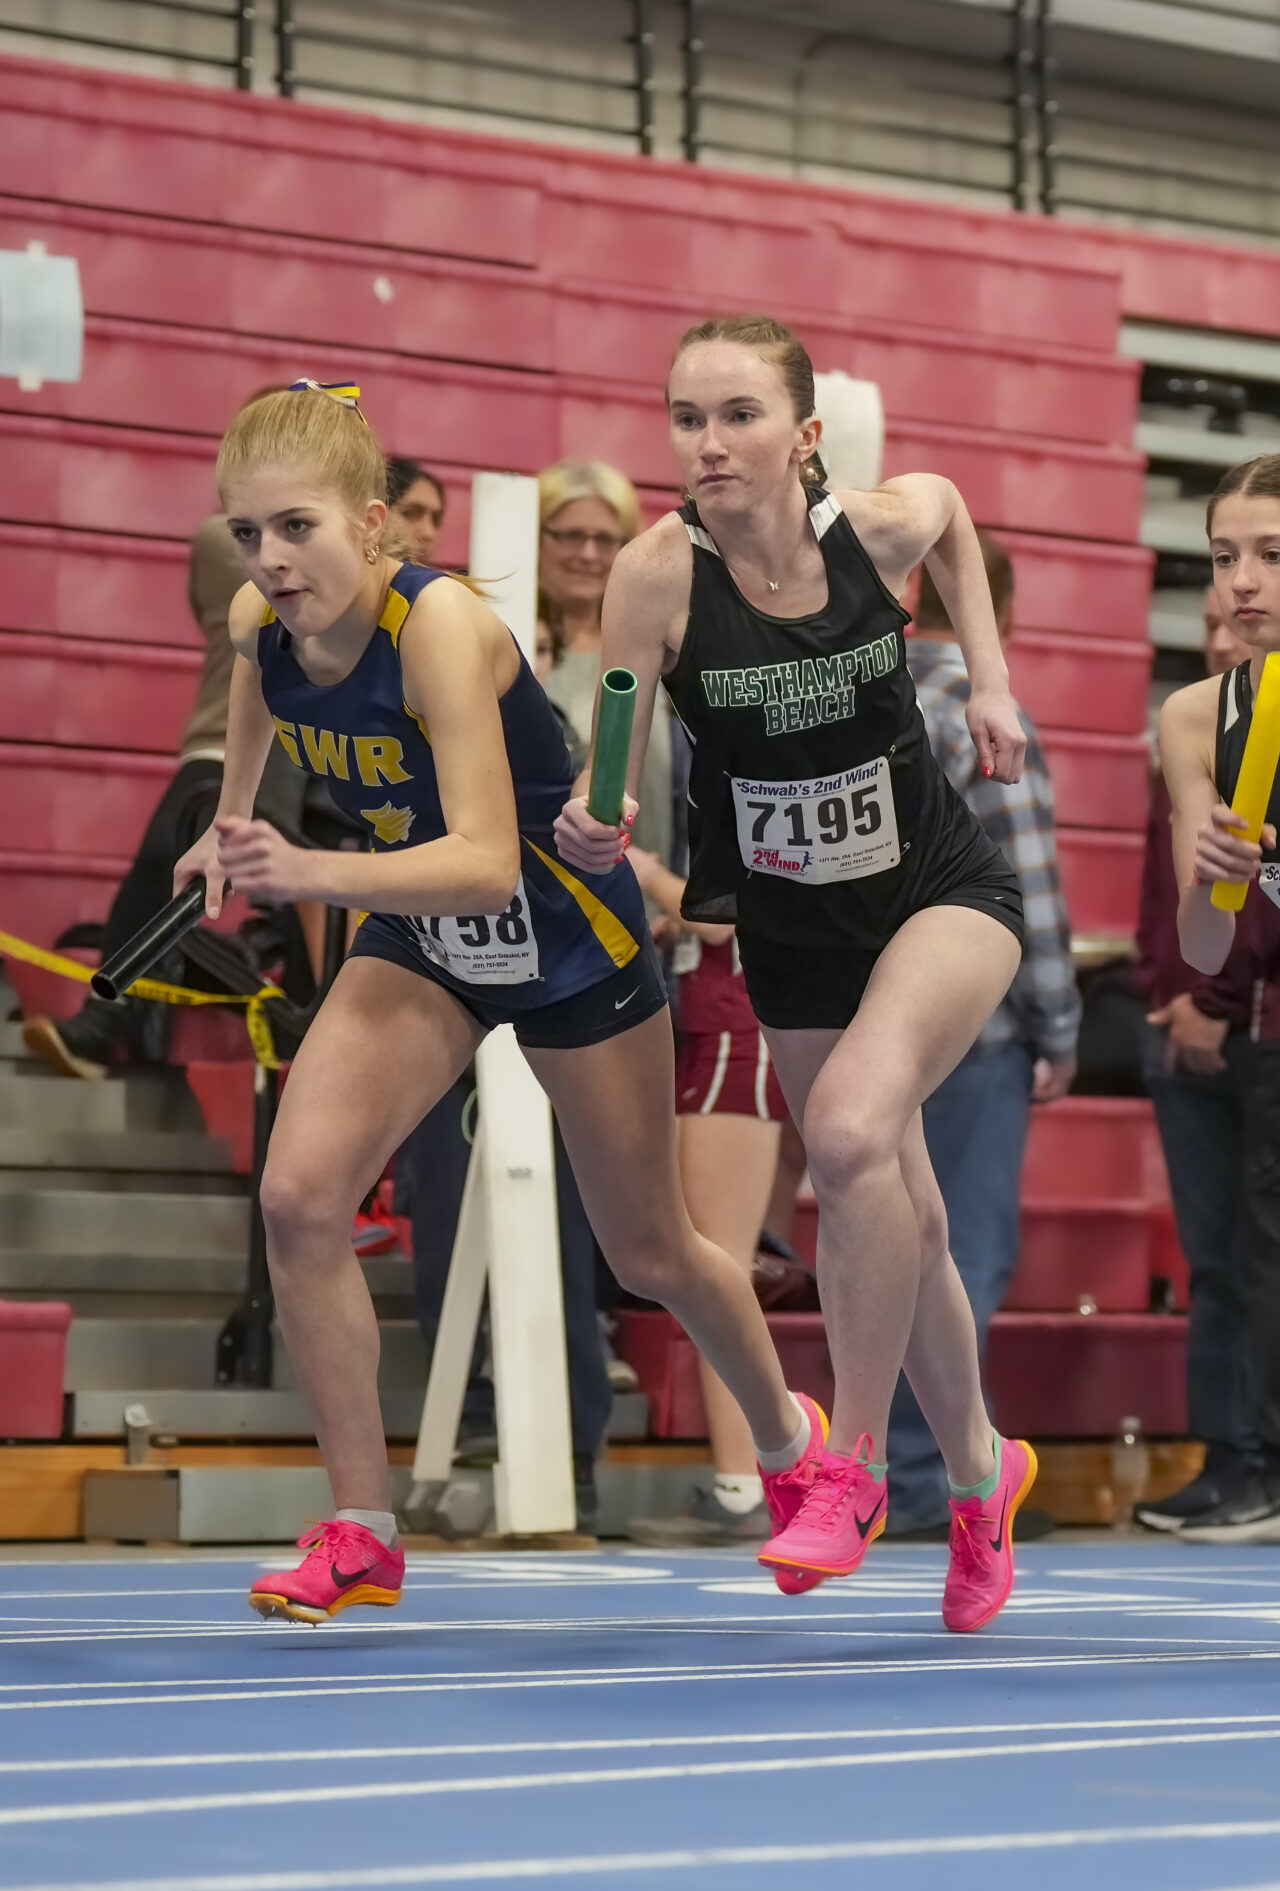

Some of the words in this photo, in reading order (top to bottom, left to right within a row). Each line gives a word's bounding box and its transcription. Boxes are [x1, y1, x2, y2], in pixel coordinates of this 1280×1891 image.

[701, 632, 898, 707] WESTHAMPTON
[764, 685, 856, 737] BEACH
[740, 781, 810, 797] Schwab's
[814, 777, 842, 794] 2nd
[846, 762, 879, 786] Wind
[746, 783, 882, 847] 7195
[752, 849, 779, 865] 2nd
[766, 859, 800, 872] WIND
